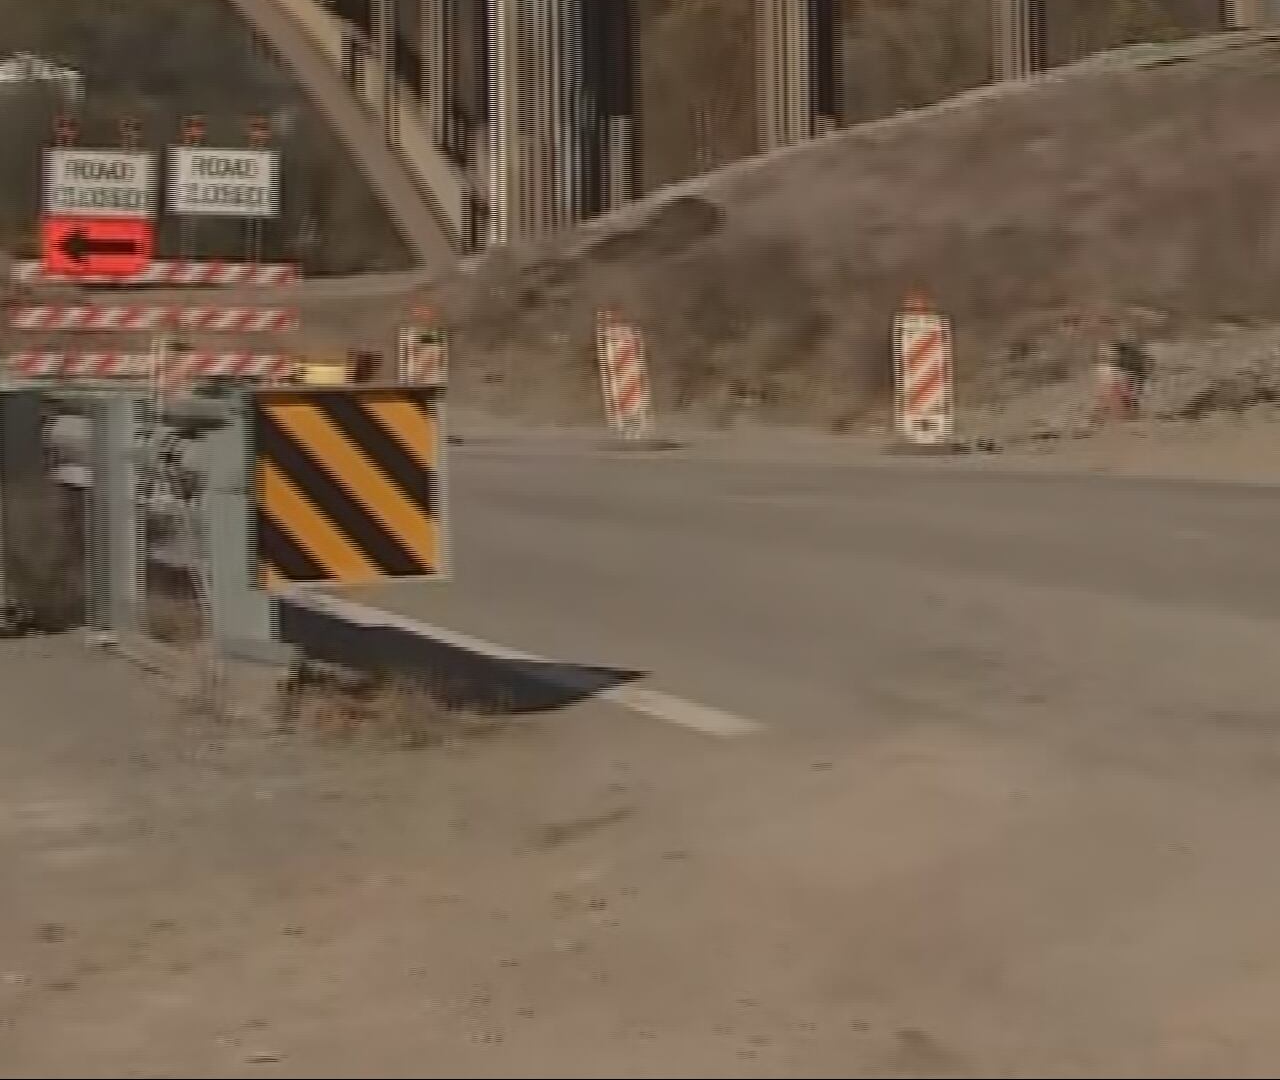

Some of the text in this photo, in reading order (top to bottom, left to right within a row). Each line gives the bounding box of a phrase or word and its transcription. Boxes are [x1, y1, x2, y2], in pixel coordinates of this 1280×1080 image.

[64, 159, 136, 182] ROAD
[191, 155, 260, 179] ROAD
[53, 184, 150, 209] CLOSED
[177, 182, 273, 206] CLOSED
